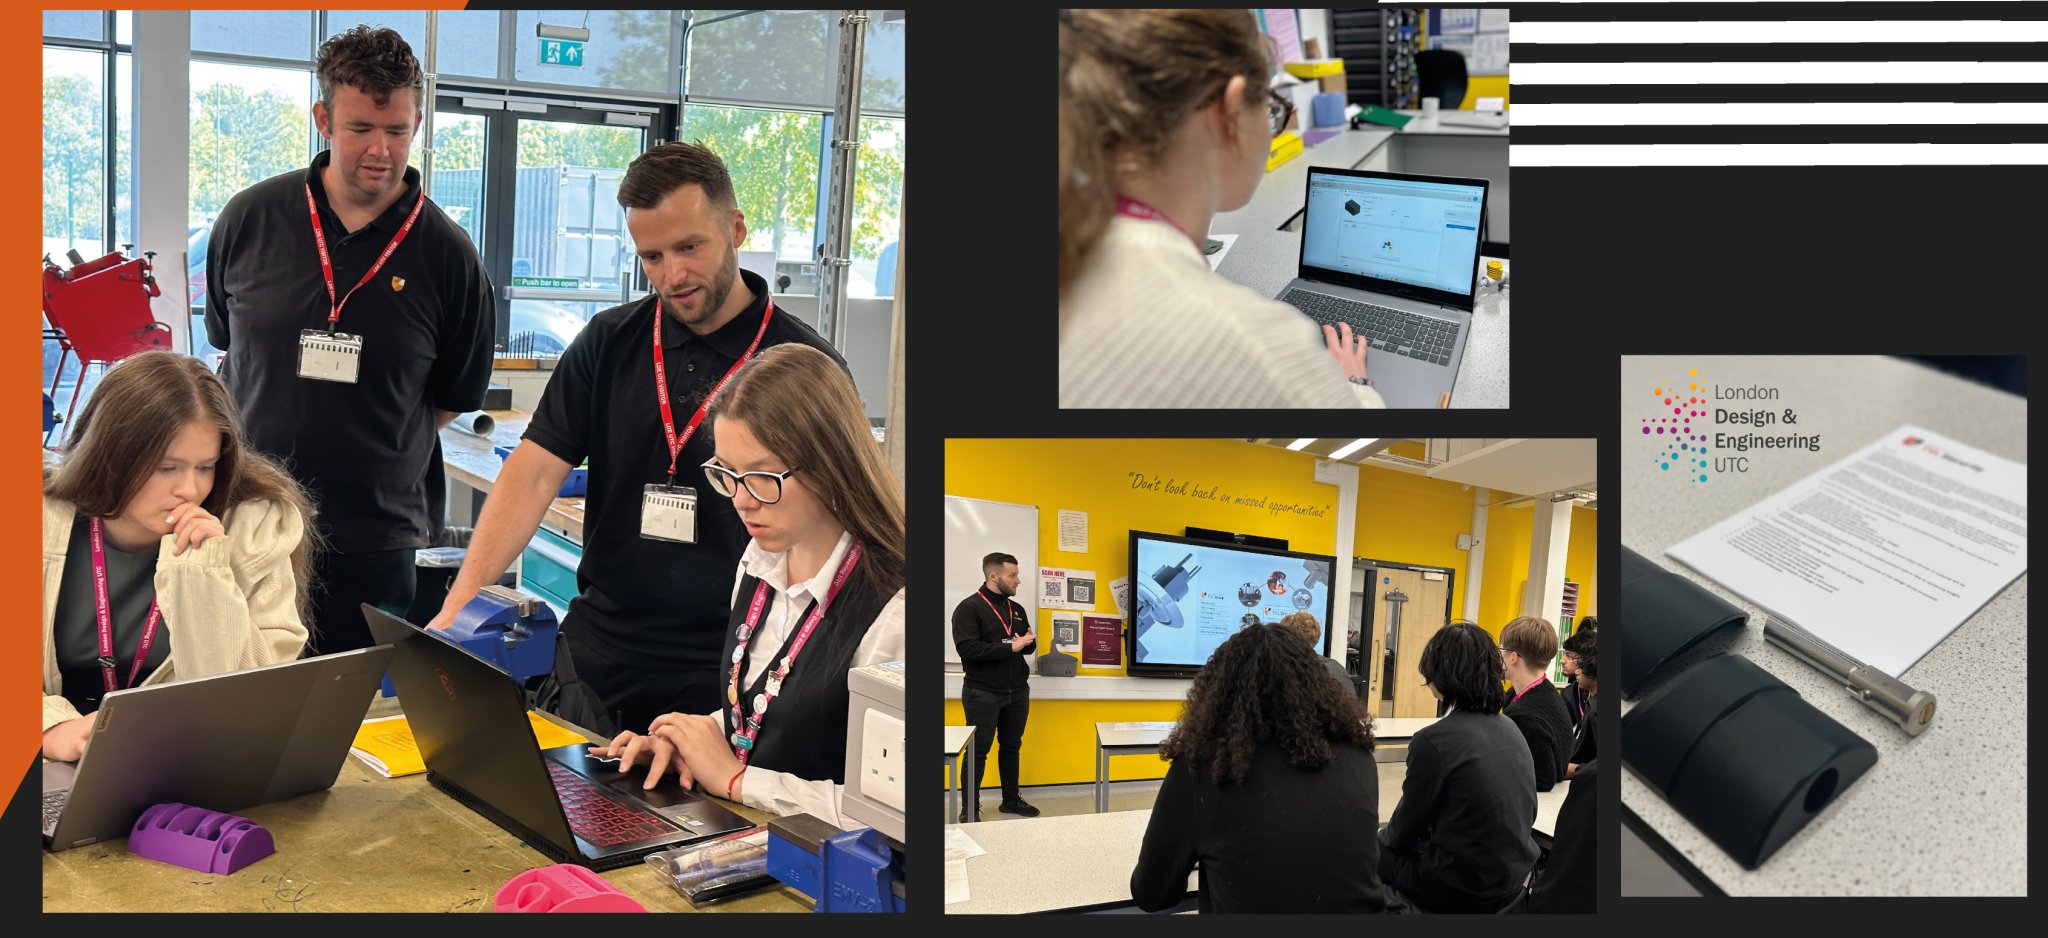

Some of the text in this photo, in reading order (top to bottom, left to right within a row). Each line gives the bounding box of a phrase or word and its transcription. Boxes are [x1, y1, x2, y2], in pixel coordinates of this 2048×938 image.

[659, 382, 667, 405] VISITOR
[680, 425, 694, 444] VISITOR
[1165, 479, 1188, 496] look
[1192, 484, 1217, 501] back
[1220, 493, 1231, 503] on
[1234, 493, 1267, 508] missed
[96, 577, 107, 609] Engineering
[144, 611, 159, 640] Engineering
[804, 616, 818, 633] Design
